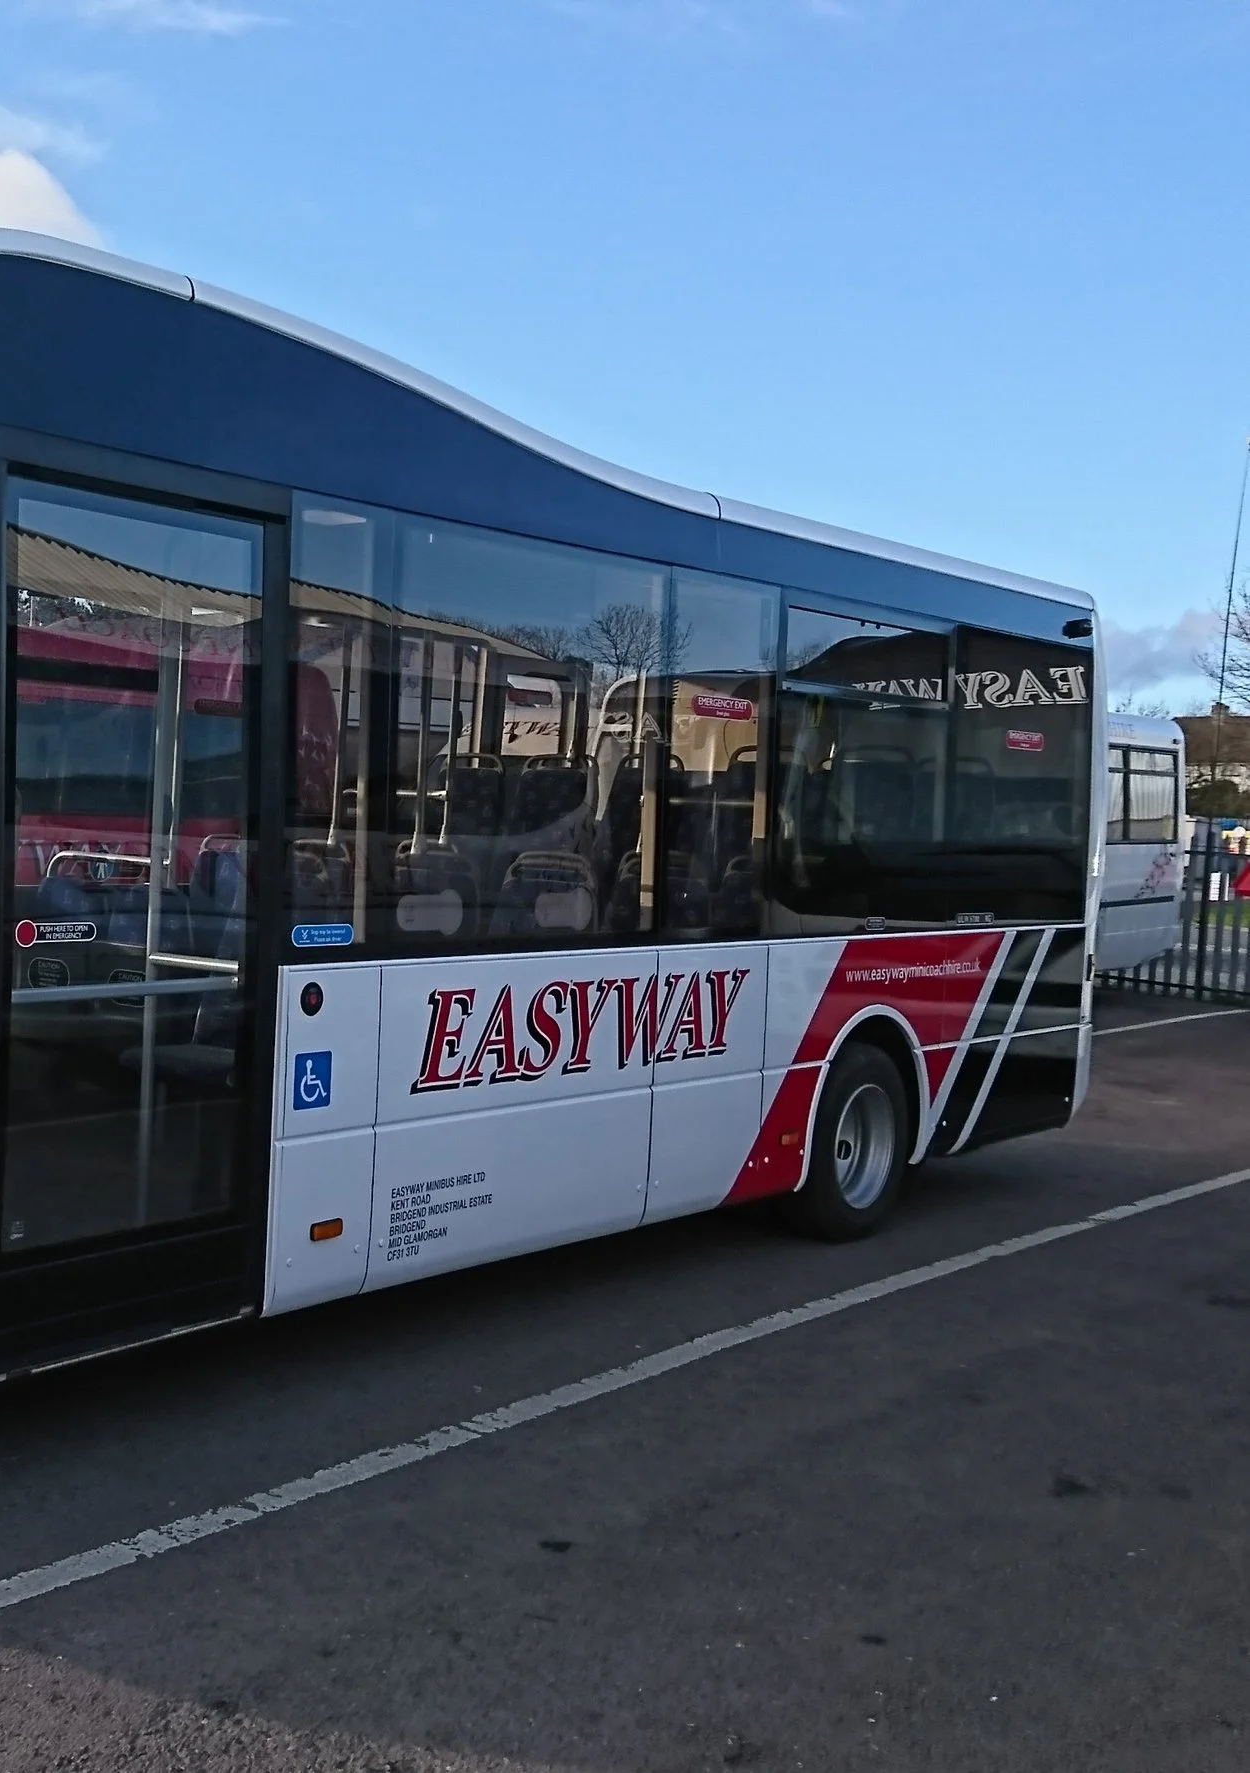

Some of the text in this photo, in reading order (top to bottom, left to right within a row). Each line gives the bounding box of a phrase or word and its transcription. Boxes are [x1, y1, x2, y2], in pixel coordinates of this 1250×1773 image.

[698, 697, 748, 710] EMERGENCY EXIT
[845, 957, 982, 985] www.easywayminicoachhire.co.uk
[409, 967, 751, 1095] EASYWAY
[391, 1171, 486, 1199] EASYWAY MINIBUS HIRE LTD
[390, 1193, 493, 1224] BRIDGEND INDUSTRIAL ESTATE
[391, 1193, 431, 1211] KENT ROAD
[388, 1226, 448, 1249] MID GLAMORGAN
[389, 1219, 426, 1236] BRIDGEND
[387, 1245, 420, 1261] CF31 3TU
